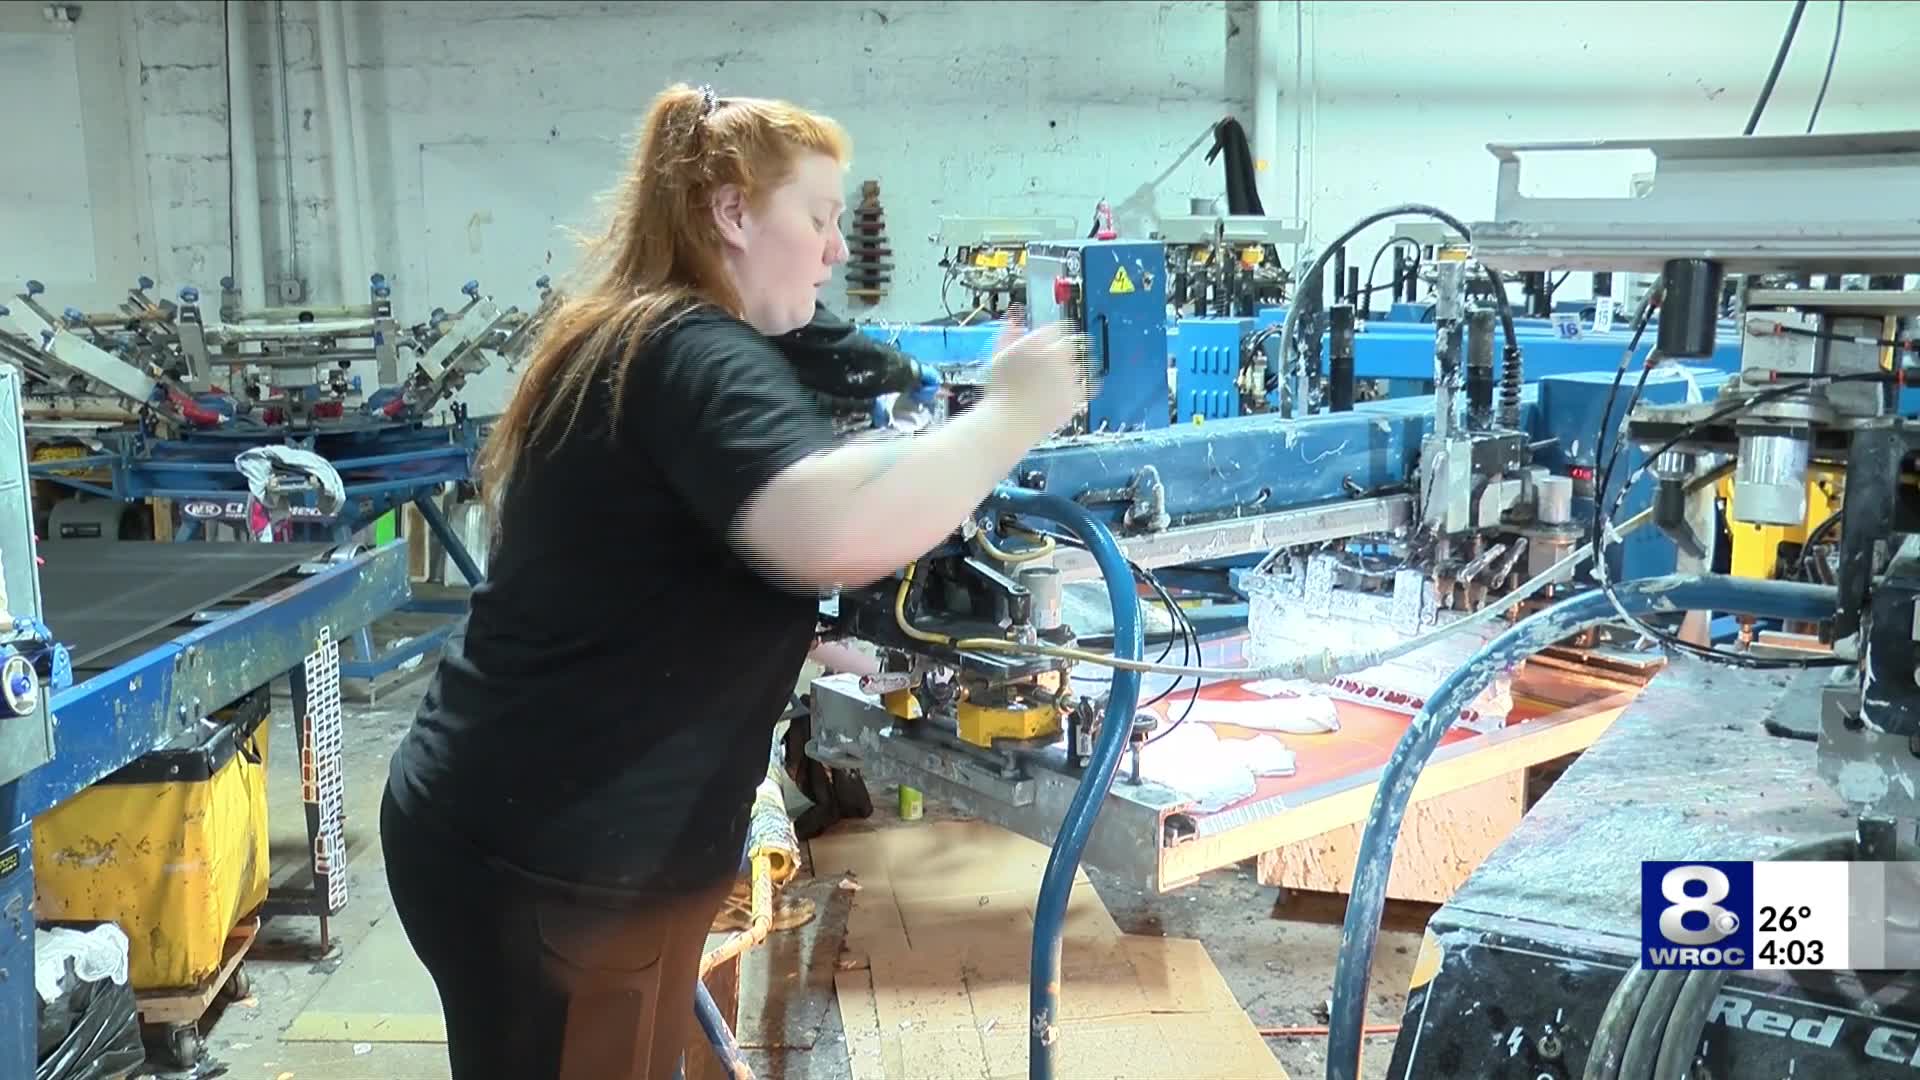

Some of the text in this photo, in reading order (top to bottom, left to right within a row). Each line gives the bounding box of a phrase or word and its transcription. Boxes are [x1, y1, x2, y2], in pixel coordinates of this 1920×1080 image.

[1558, 323, 1579, 336] 16
[1706, 995, 1920, 1068] Red C
